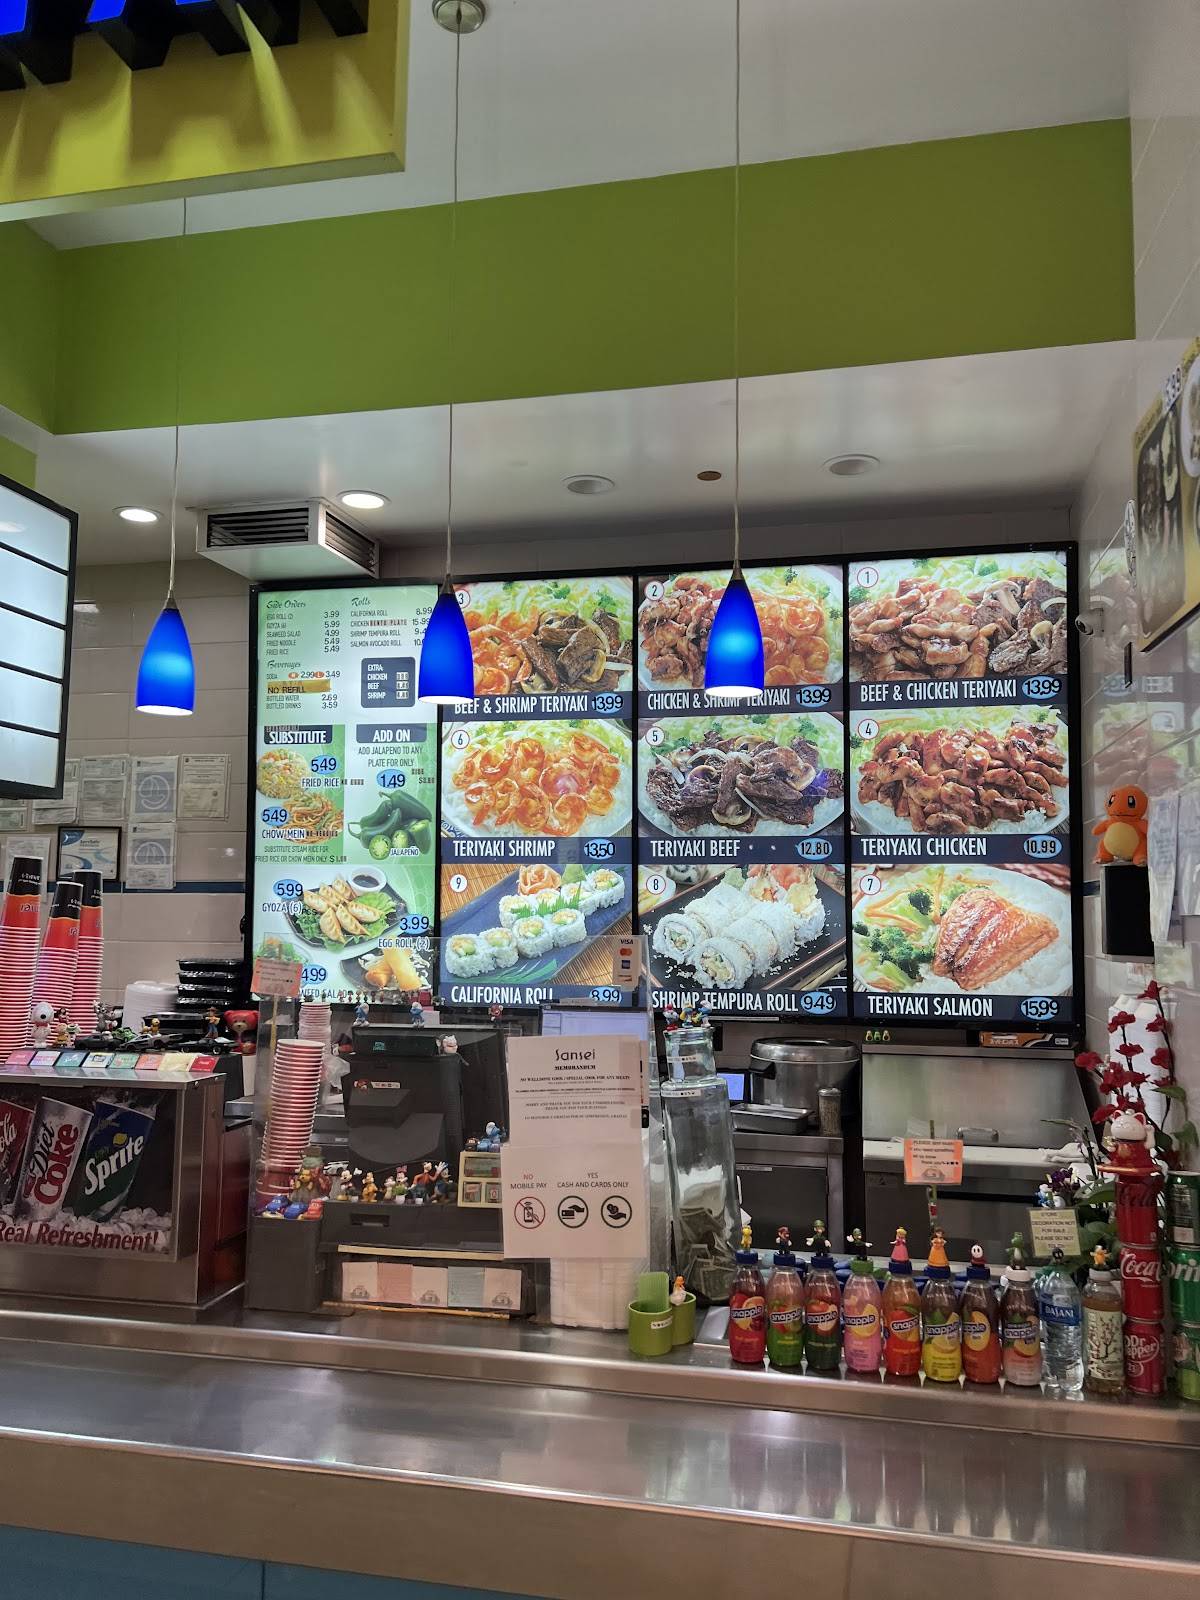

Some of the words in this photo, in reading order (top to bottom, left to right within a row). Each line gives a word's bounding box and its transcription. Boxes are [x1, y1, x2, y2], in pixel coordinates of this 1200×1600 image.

[865, 572, 870, 584] 1
[652, 585, 657, 596] 2
[284, 600, 306, 608] Orders
[351, 597, 370, 606] Rolls
[459, 594, 464, 604] 3
[416, 606, 432, 615] 8.99
[268, 686, 280, 694] NO
[282, 686, 304, 694] REFILL
[368, 682, 380, 690] BEEF
[860, 684, 889, 702] BEEF
[893, 684, 902, 701] &
[906, 681, 958, 700] CHICKEN
[962, 679, 1017, 699] TERIYAKI
[1024, 680, 1062, 695] 13.99
[455, 698, 479, 714] BEEF
[484, 699, 492, 714] &
[496, 697, 536, 713] SHRIMP
[540, 695, 588, 712] TERIYAKI
[592, 696, 623, 712] 13.99
[648, 694, 690, 710] CHICKEN
[693, 694, 701, 708] &
[704, 694, 744, 708] SHRIMP
[746, 689, 790, 706] TERIYAKI
[796, 689, 831, 704] 13.99
[373, 730, 393, 742] ADD
[396, 729, 411, 742] ON
[652, 730, 658, 742] 5
[865, 724, 871, 736] 4
[269, 730, 326, 744] SUBSTITUTE
[458, 735, 463, 745] 6
[358, 747, 370, 755] ADD
[371, 746, 401, 755] JALAPENO
[402, 746, 410, 754] TO
[411, 746, 423, 754] ANY
[368, 759, 386, 767] PLATE
[387, 759, 398, 767] FOR
[400, 758, 414, 767] ONLY
[302, 778, 322, 787] FRIED
[324, 778, 339, 787] RICE
[262, 830, 284, 838] CHOW
[287, 829, 305, 838] MEIN
[453, 840, 504, 857] TERIYAKI
[508, 840, 555, 856] SHRIMP
[585, 843, 615, 857] 13.50
[650, 840, 705, 857] TERIYAKI
[710, 840, 740, 857] BEEF
[801, 842, 830, 855] 12.80
[861, 838, 921, 856] TERIYAKI
[926, 838, 987, 856] CHICKEN
[1026, 840, 1056, 853] 10.99
[456, 878, 461, 889] 9
[654, 879, 659, 890] 8
[867, 879, 873, 891] 7
[262, 902, 287, 912] GYOZA
[289, 901, 302, 913] (6)
[400, 916, 429, 930] 3.99
[378, 938, 393, 948] EGG
[395, 938, 412, 948] ROLL
[451, 986, 522, 1004] CALIFORNIA
[652, 991, 699, 1008] SHRIMP
[703, 992, 762, 1011] TEMPURA
[767, 993, 798, 1012] ROLL
[804, 997, 836, 1010] 9.49
[868, 996, 928, 1015] TERIYAKI
[934, 997, 993, 1017] SALMON
[1023, 1001, 1058, 1017] 15.99
[556, 1049, 595, 1061] Sansei
[0, 1112, 17, 1152] ola
[31, 1120, 55, 1178] Diet
[34, 1124, 78, 1204] Coke
[84, 1135, 144, 1195] Sprite
[0, 1222, 32, 1242] Real
[37, 1221, 158, 1250] Refreshment!
[731, 1306, 762, 1318] snapple
[808, 1311, 837, 1322] snapple
[1046, 1306, 1073, 1317] DASANI
[1131, 1335, 1146, 1346] Dr
